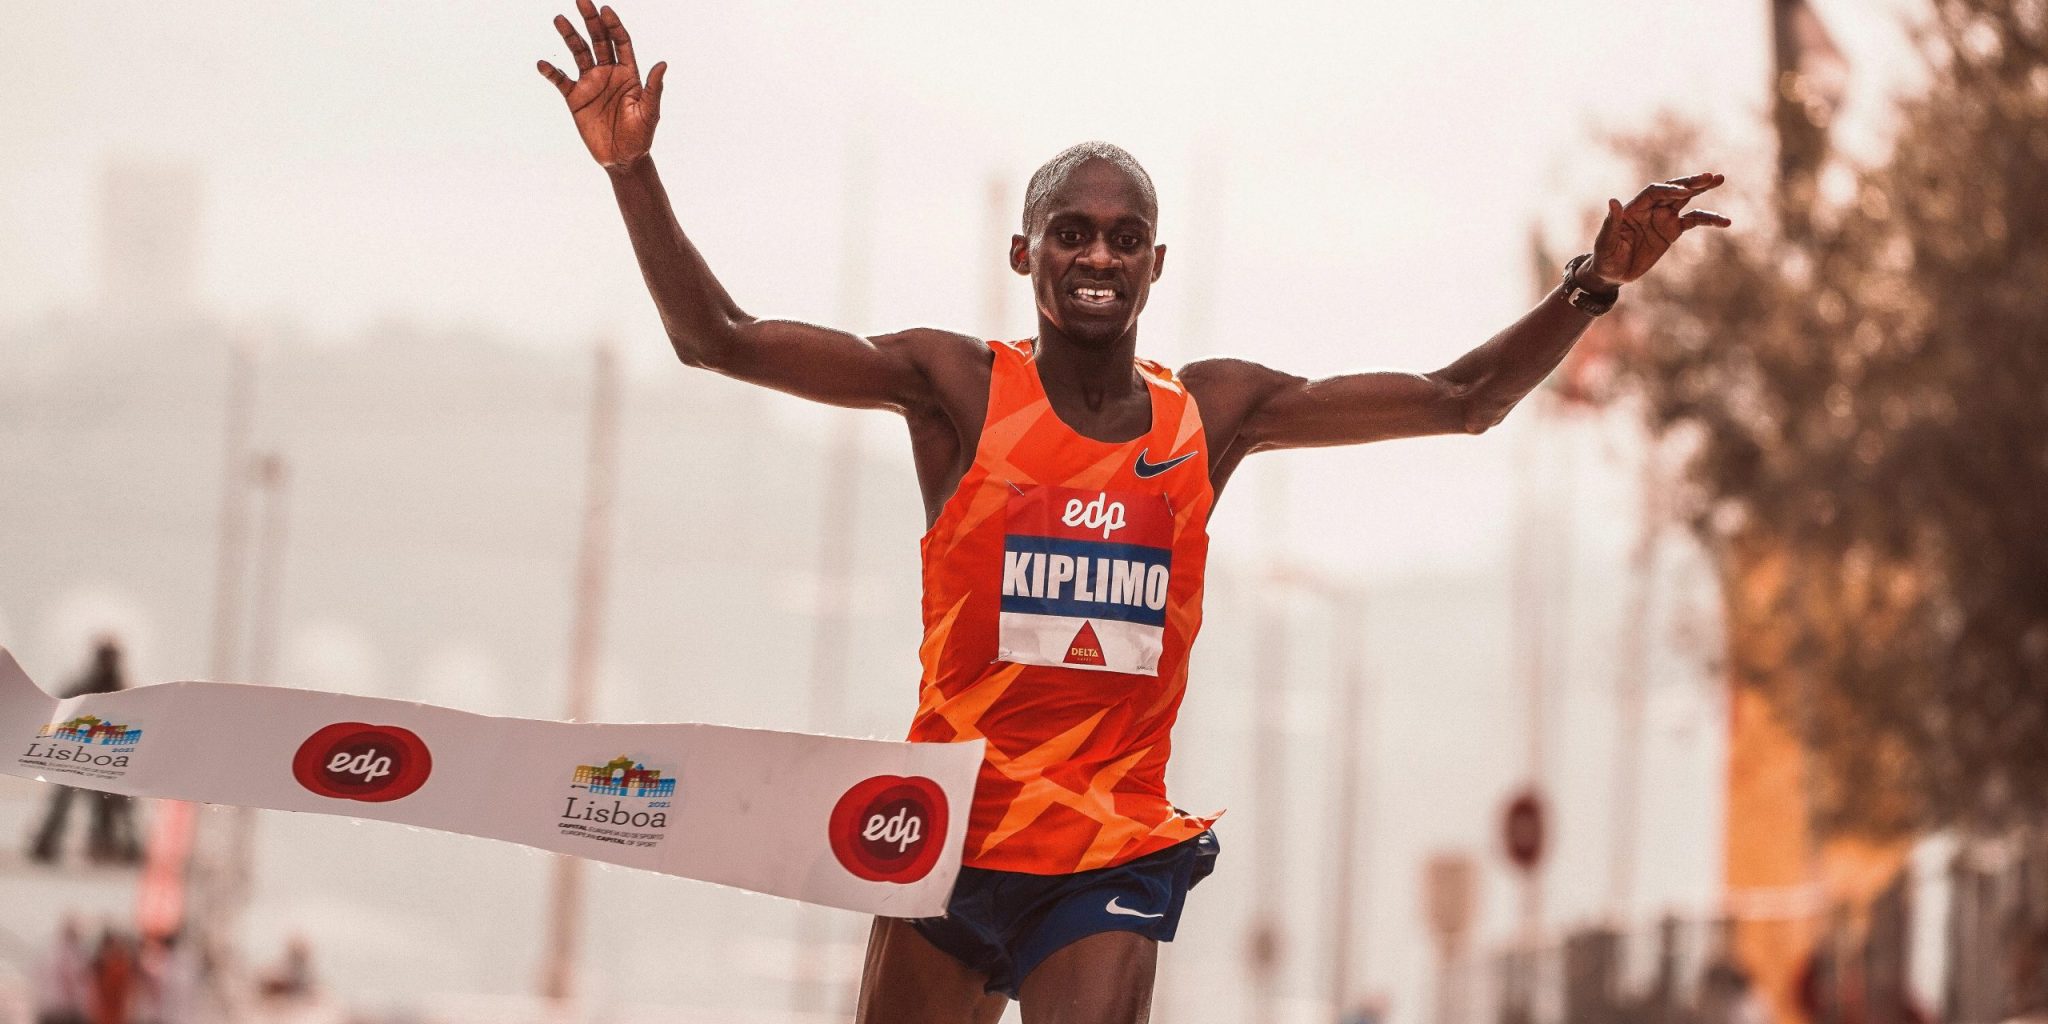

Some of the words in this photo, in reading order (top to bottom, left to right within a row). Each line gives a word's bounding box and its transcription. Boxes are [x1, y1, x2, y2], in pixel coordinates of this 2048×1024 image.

[1061, 491, 1127, 540] edp
[1002, 550, 1170, 611] KIPLIMO
[1071, 647, 1099, 657] DELTA
[23, 743, 129, 768] Lisboa
[326, 748, 392, 783] edp
[558, 822, 587, 830] CAPITAL
[561, 797, 666, 828] Lisboa
[596, 835, 625, 844] CAPITAL
[861, 807, 921, 853] edp
